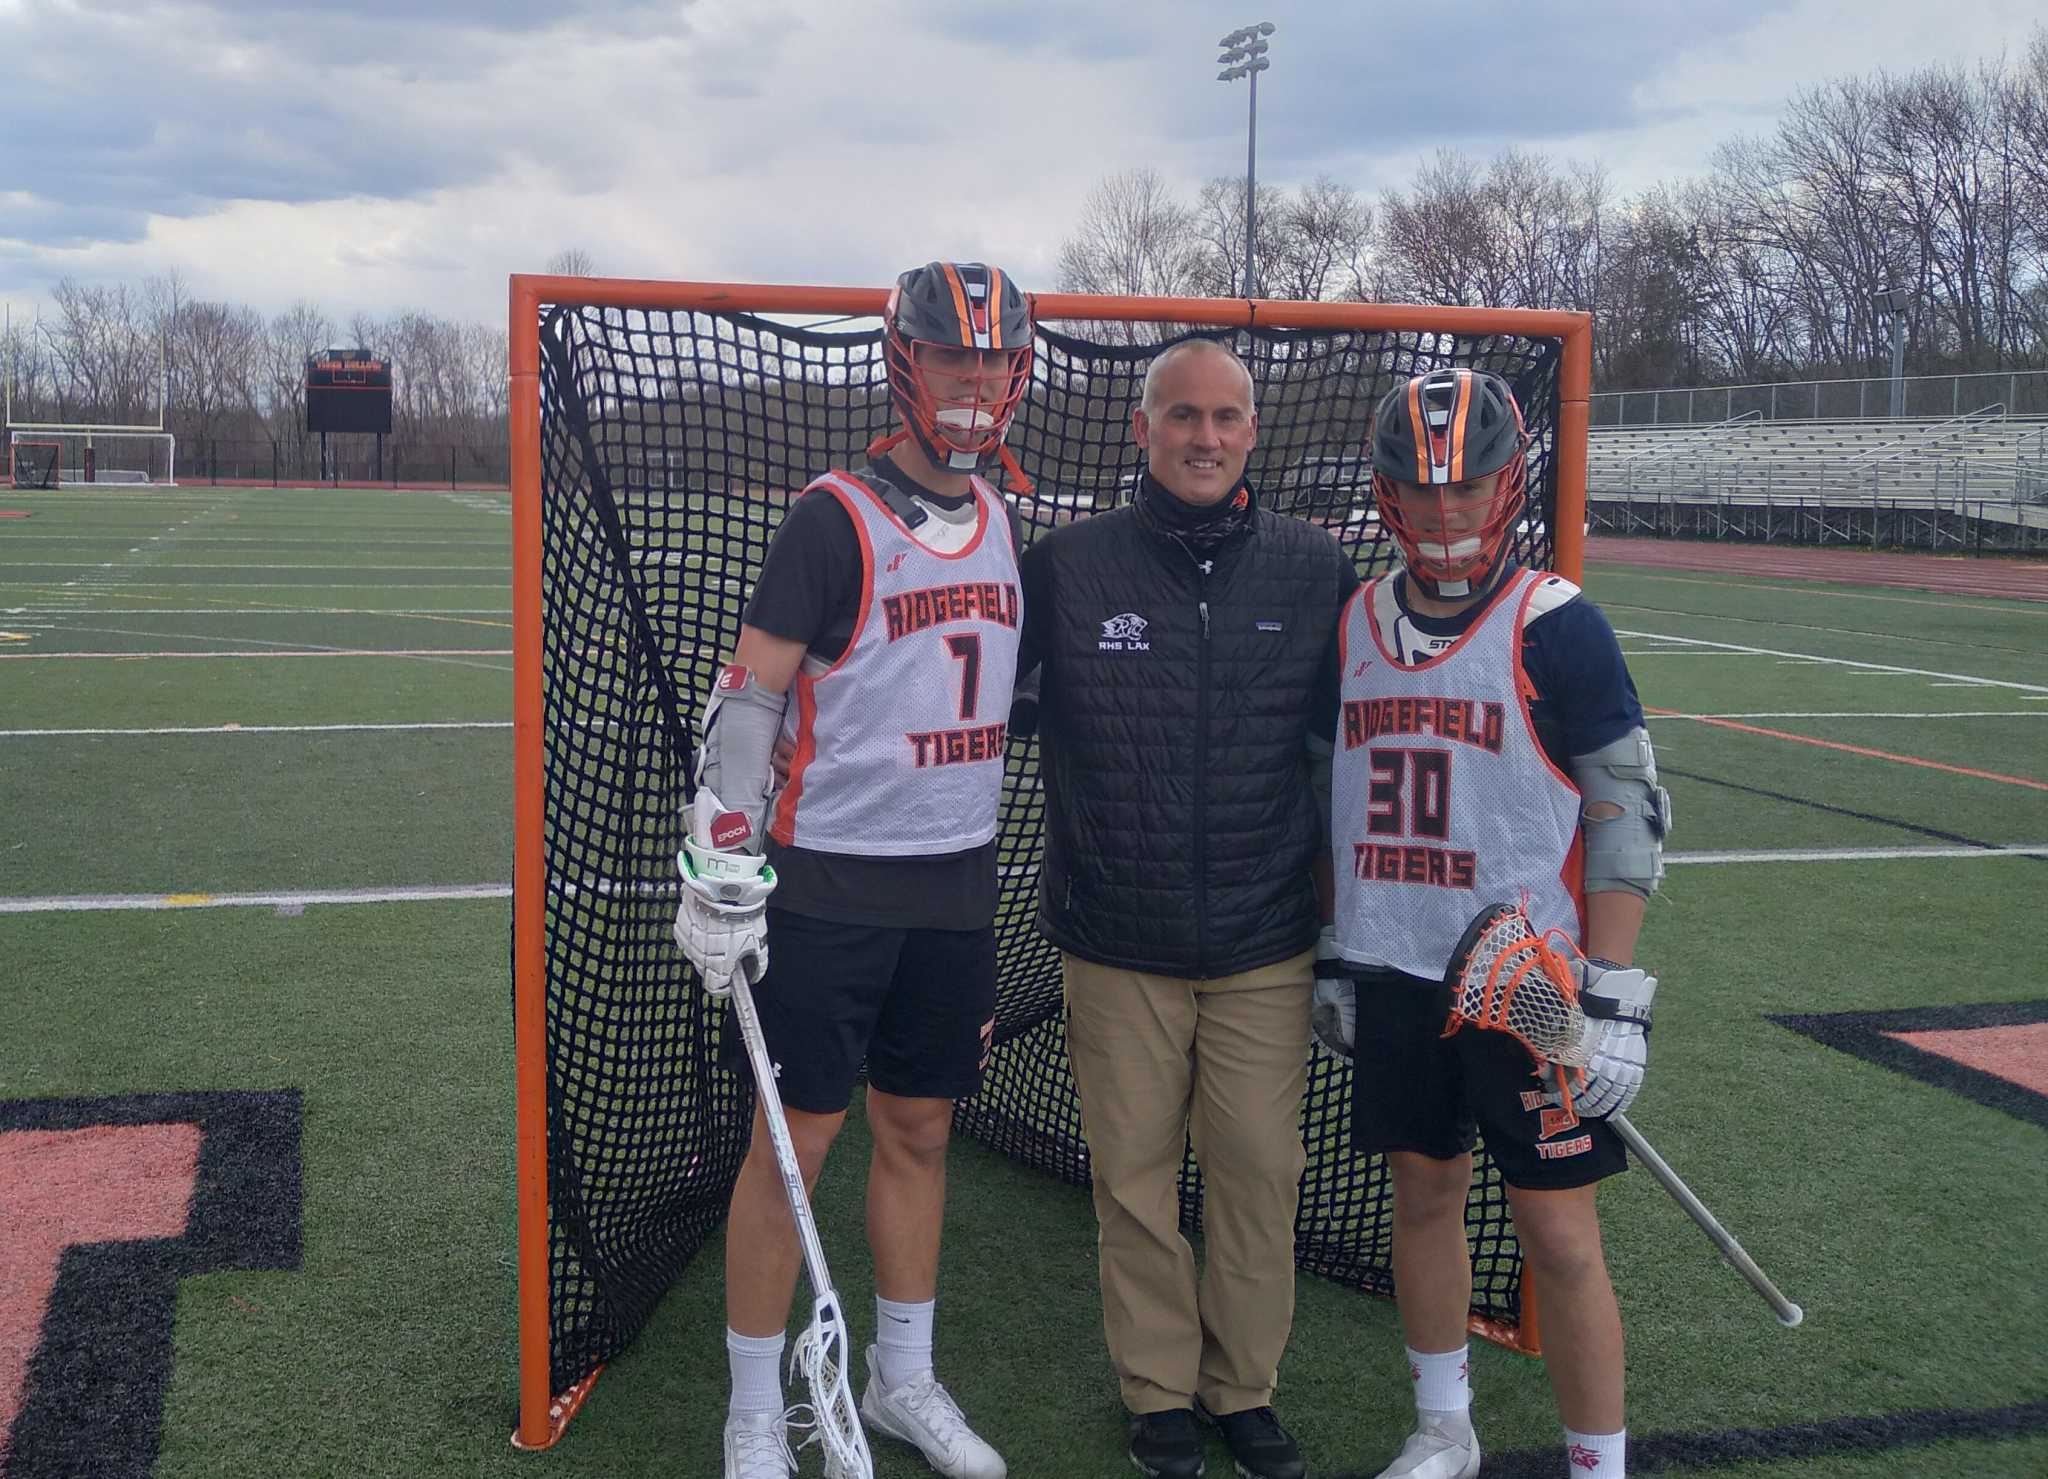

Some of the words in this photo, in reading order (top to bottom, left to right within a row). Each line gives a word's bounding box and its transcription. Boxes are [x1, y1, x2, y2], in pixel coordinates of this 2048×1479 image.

[881, 582, 1017, 643] RIDGEFIELD
[1098, 641, 1122, 650] RHS
[1126, 641, 1150, 650] LAX
[1343, 697, 1505, 755] RIDGEFIELD
[1367, 747, 1452, 841] 30
[717, 825, 747, 843] EPOCH
[1352, 842, 1476, 890] TIGERS
[1535, 1135, 1592, 1160] TIGERS
